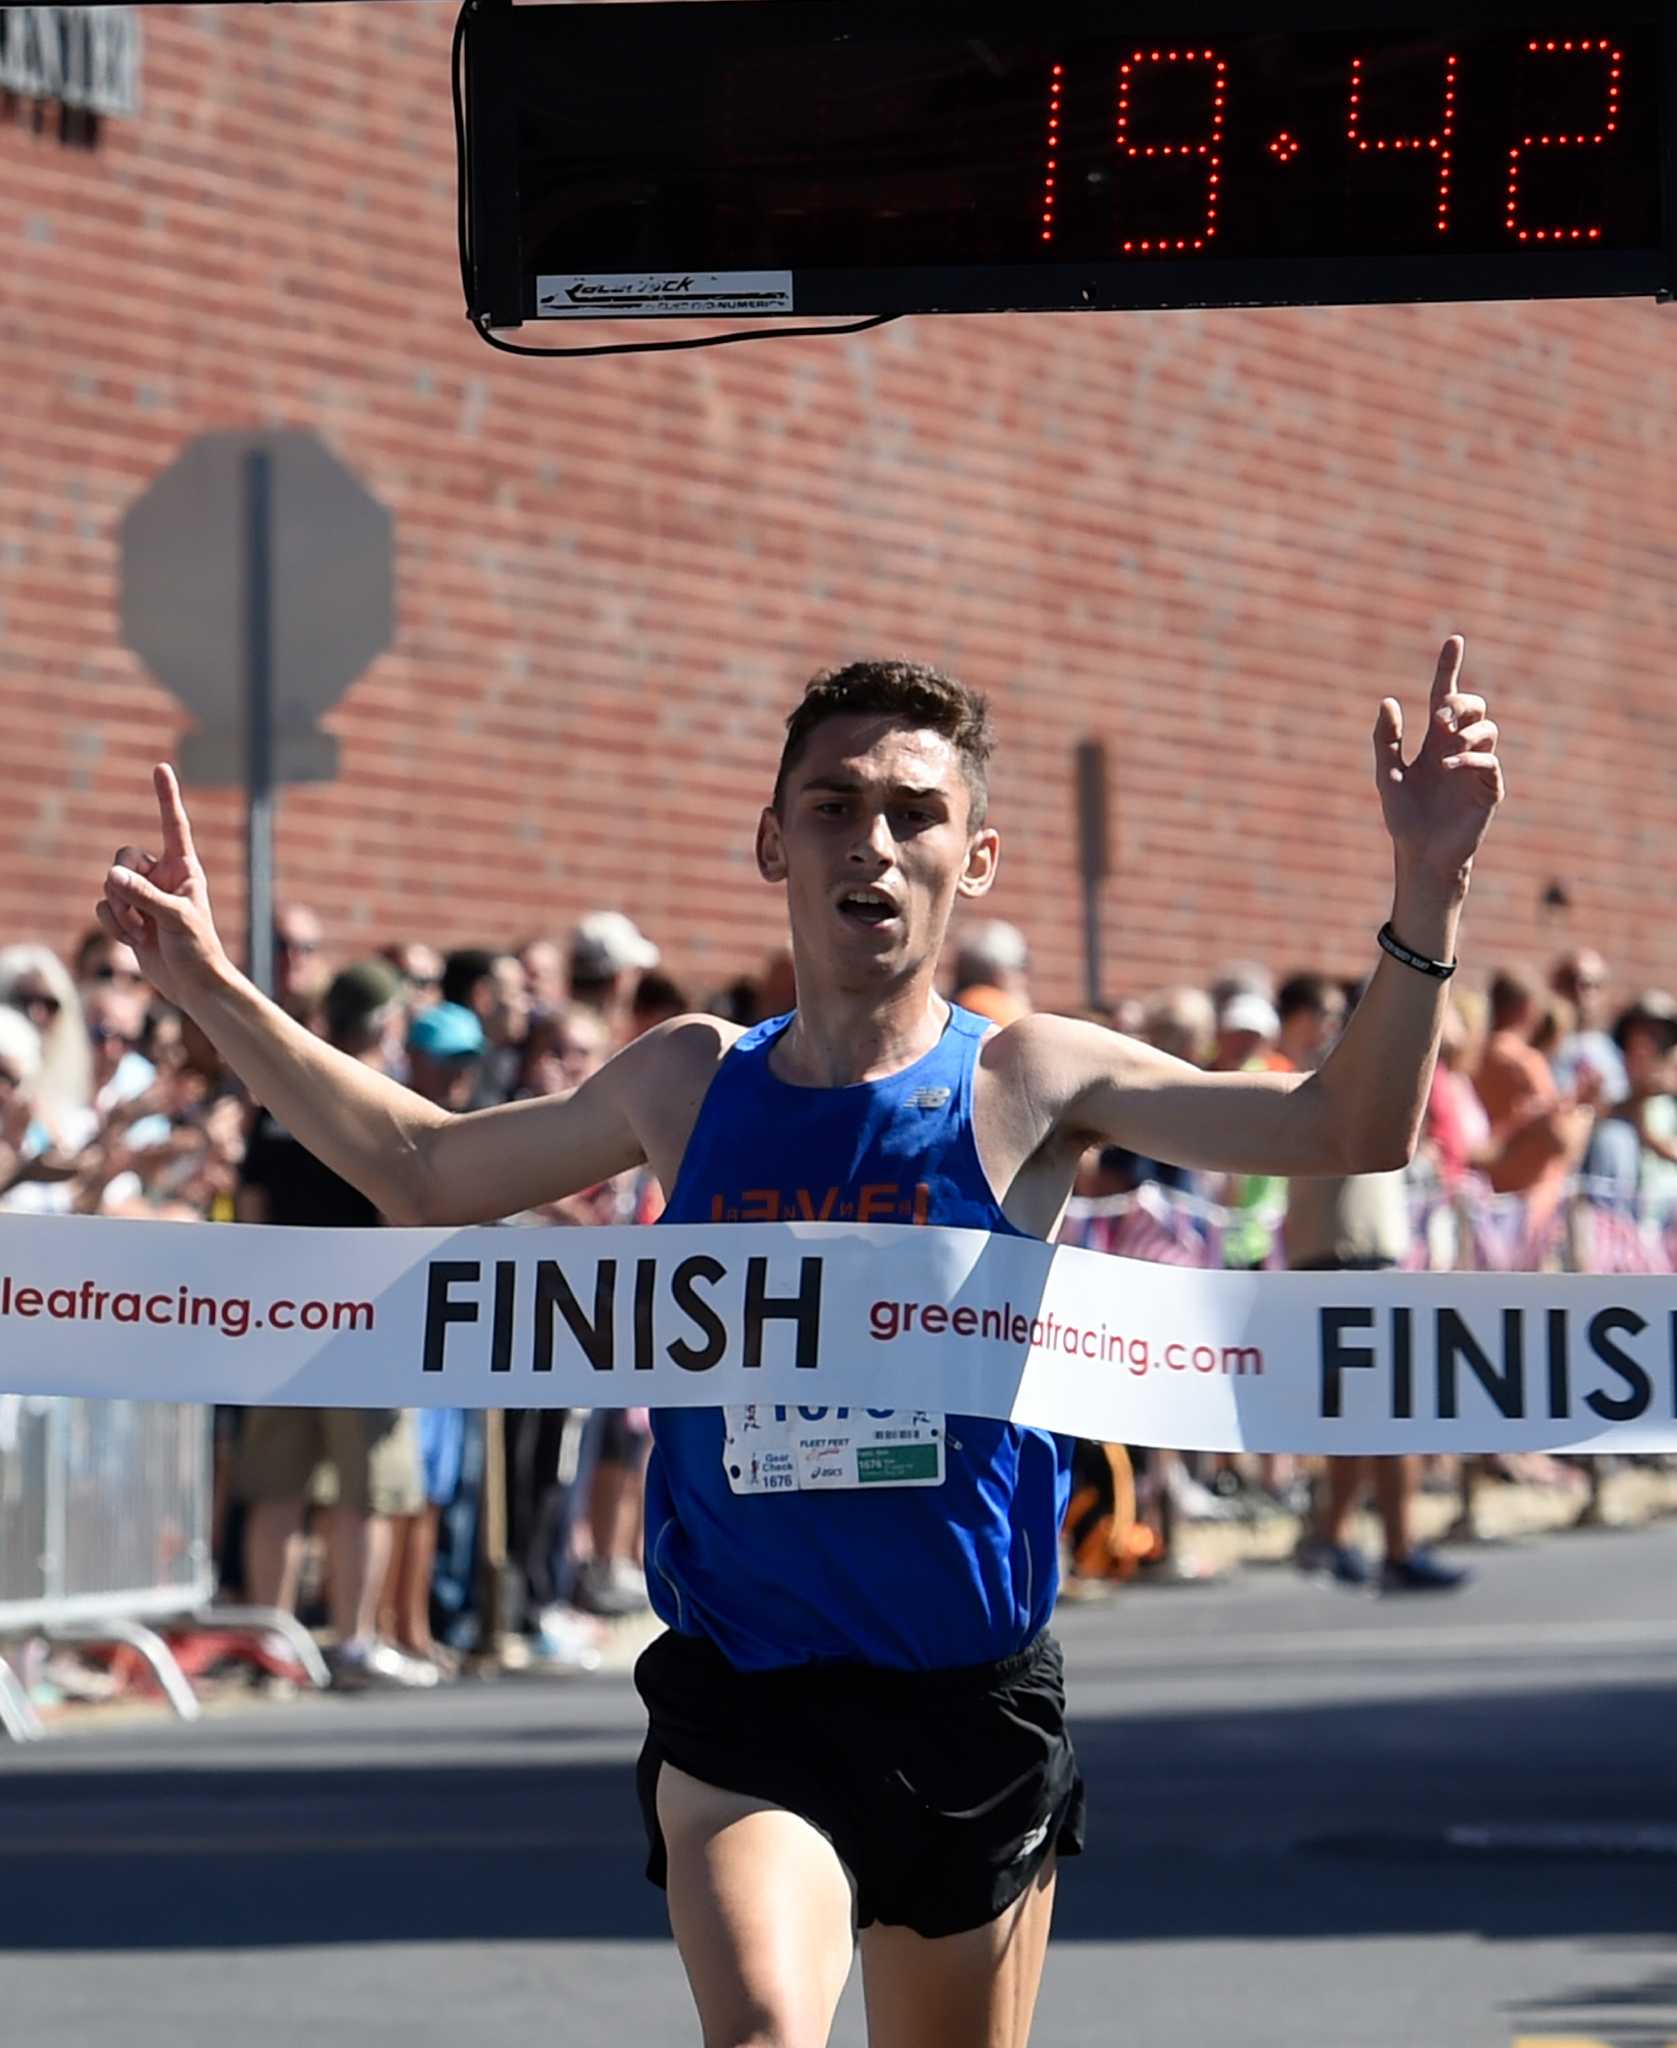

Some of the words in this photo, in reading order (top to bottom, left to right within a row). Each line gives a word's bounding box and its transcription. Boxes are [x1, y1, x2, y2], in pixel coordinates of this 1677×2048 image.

[2, 1276, 376, 1338] leafracing.com
[422, 1255, 823, 1373] FINISH
[869, 1299, 1265, 1376] greenleafracing.com
[1319, 1306, 1677, 1422] FINIS
[763, 1474, 793, 1488] 1676
